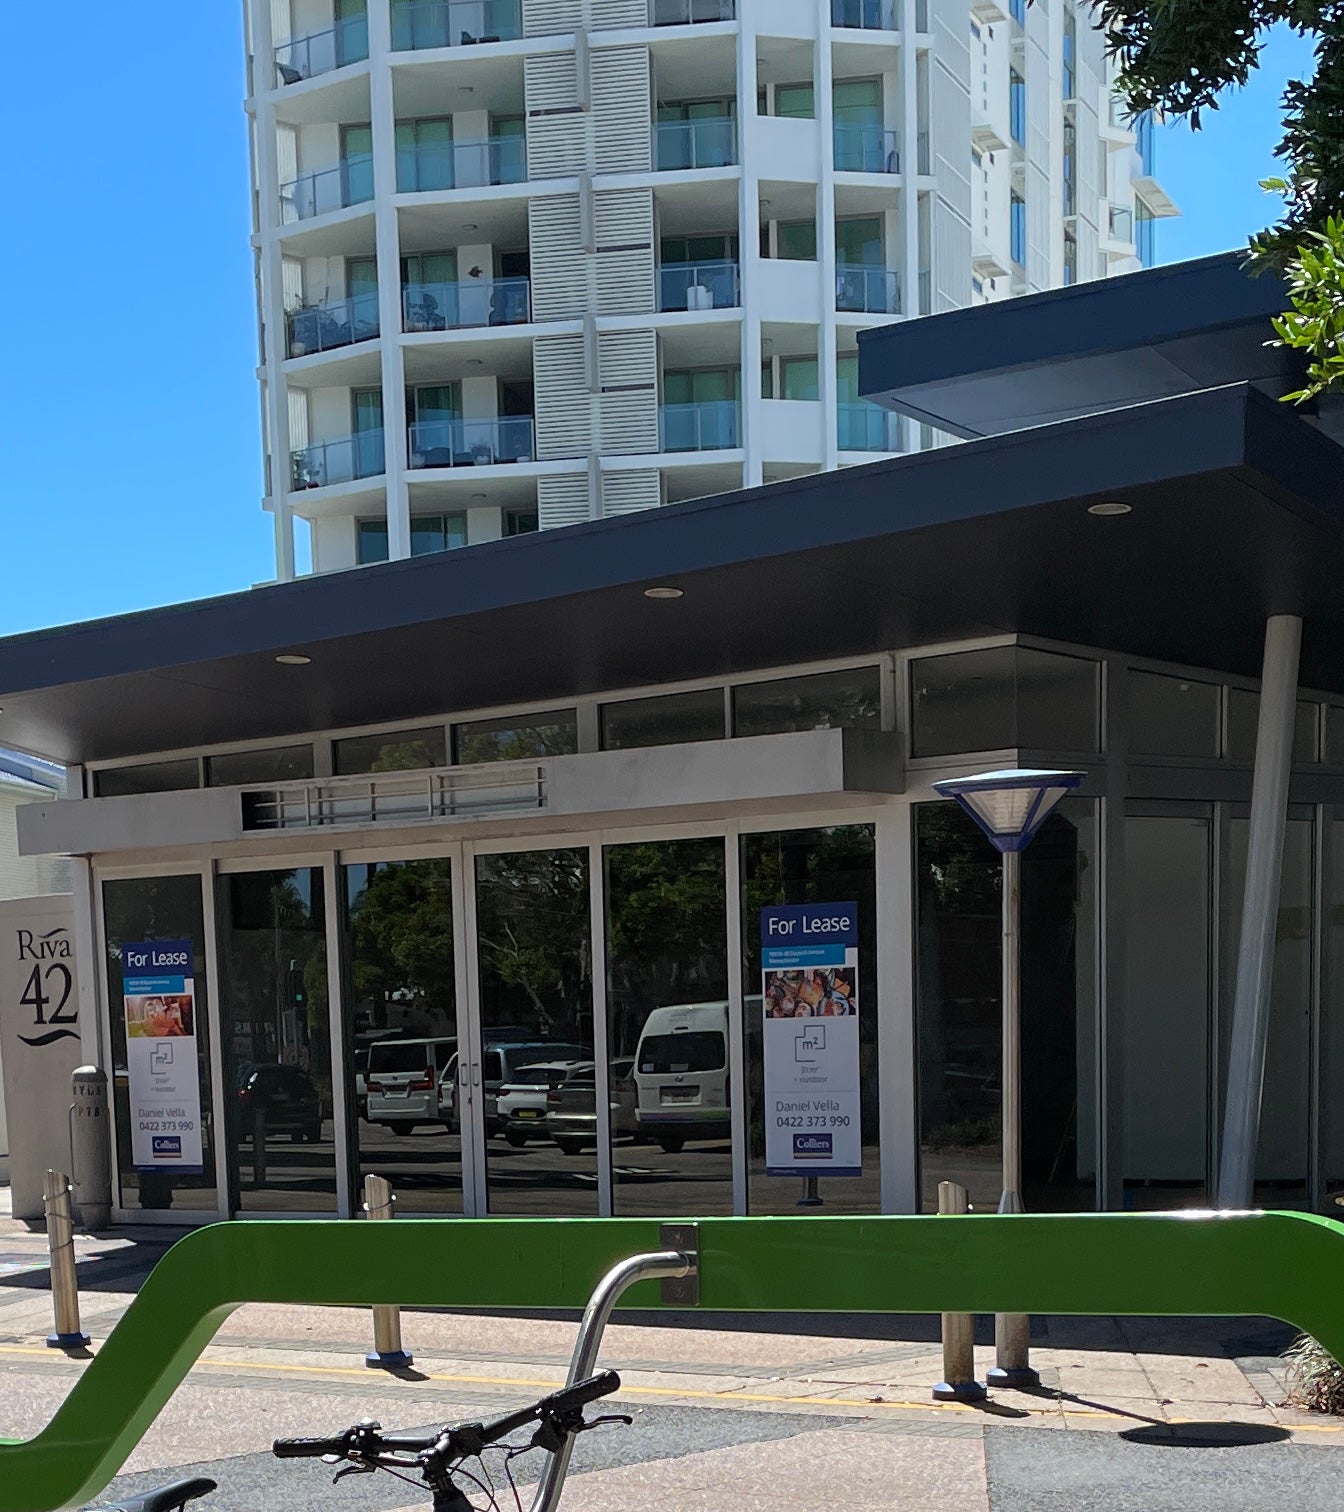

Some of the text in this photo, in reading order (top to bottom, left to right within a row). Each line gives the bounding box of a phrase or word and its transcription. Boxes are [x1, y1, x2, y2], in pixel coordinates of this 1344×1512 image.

[769, 915, 850, 935] For Lease
[16, 928, 73, 960] Riva
[127, 950, 188, 968] For Lease
[19, 963, 78, 1025] 42
[776, 1100, 840, 1112] Daniel Vella
[138, 1108, 186, 1119] Daniel Vella
[139, 1120, 194, 1132] 0422 373 990
[777, 1115, 850, 1128] 0422 373 990
[796, 1137, 830, 1150] Colliers
